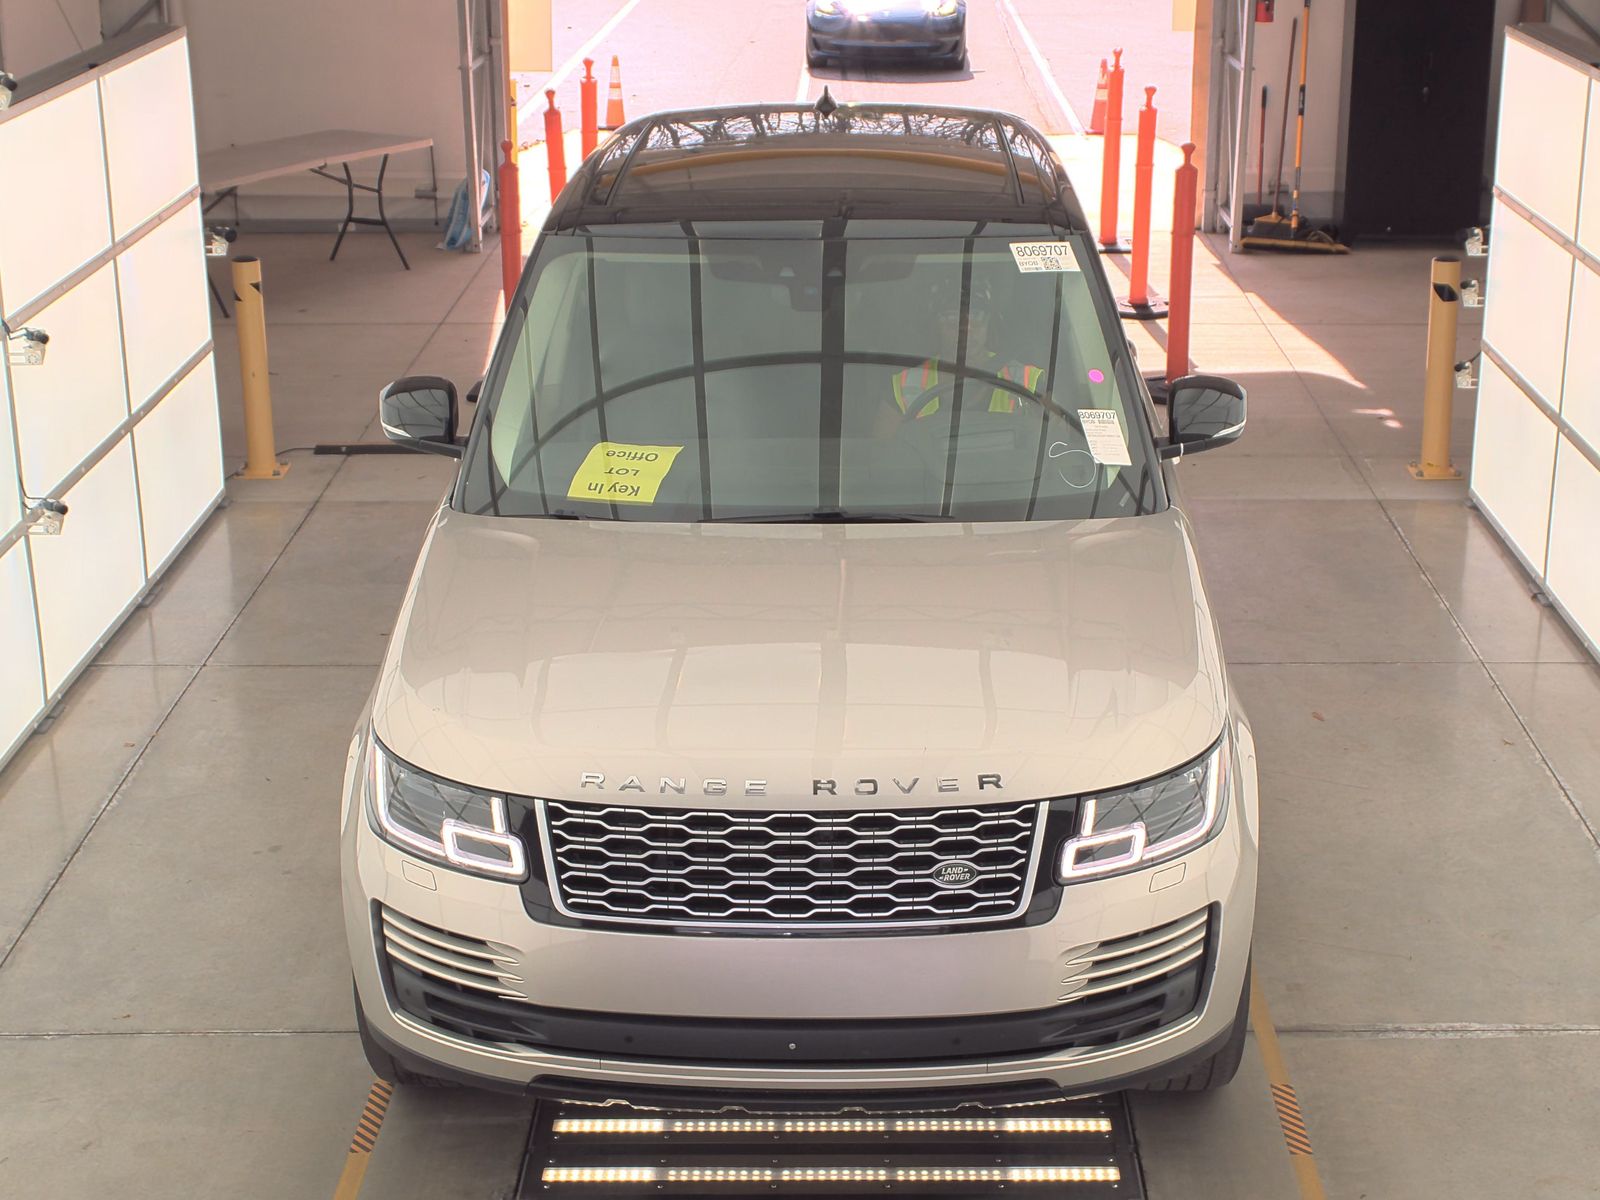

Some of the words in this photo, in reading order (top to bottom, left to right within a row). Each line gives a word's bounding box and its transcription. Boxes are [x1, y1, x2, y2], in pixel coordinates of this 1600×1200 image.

[1016, 245, 1067, 257] 8069707
[605, 449, 659, 462] Office
[603, 466, 641, 477] LOT
[587, 482, 605, 495] In
[607, 481, 641, 497] Key
[580, 771, 768, 796] RANGE
[812, 773, 1005, 796] ROVER
[943, 873, 971, 881] ROVER
